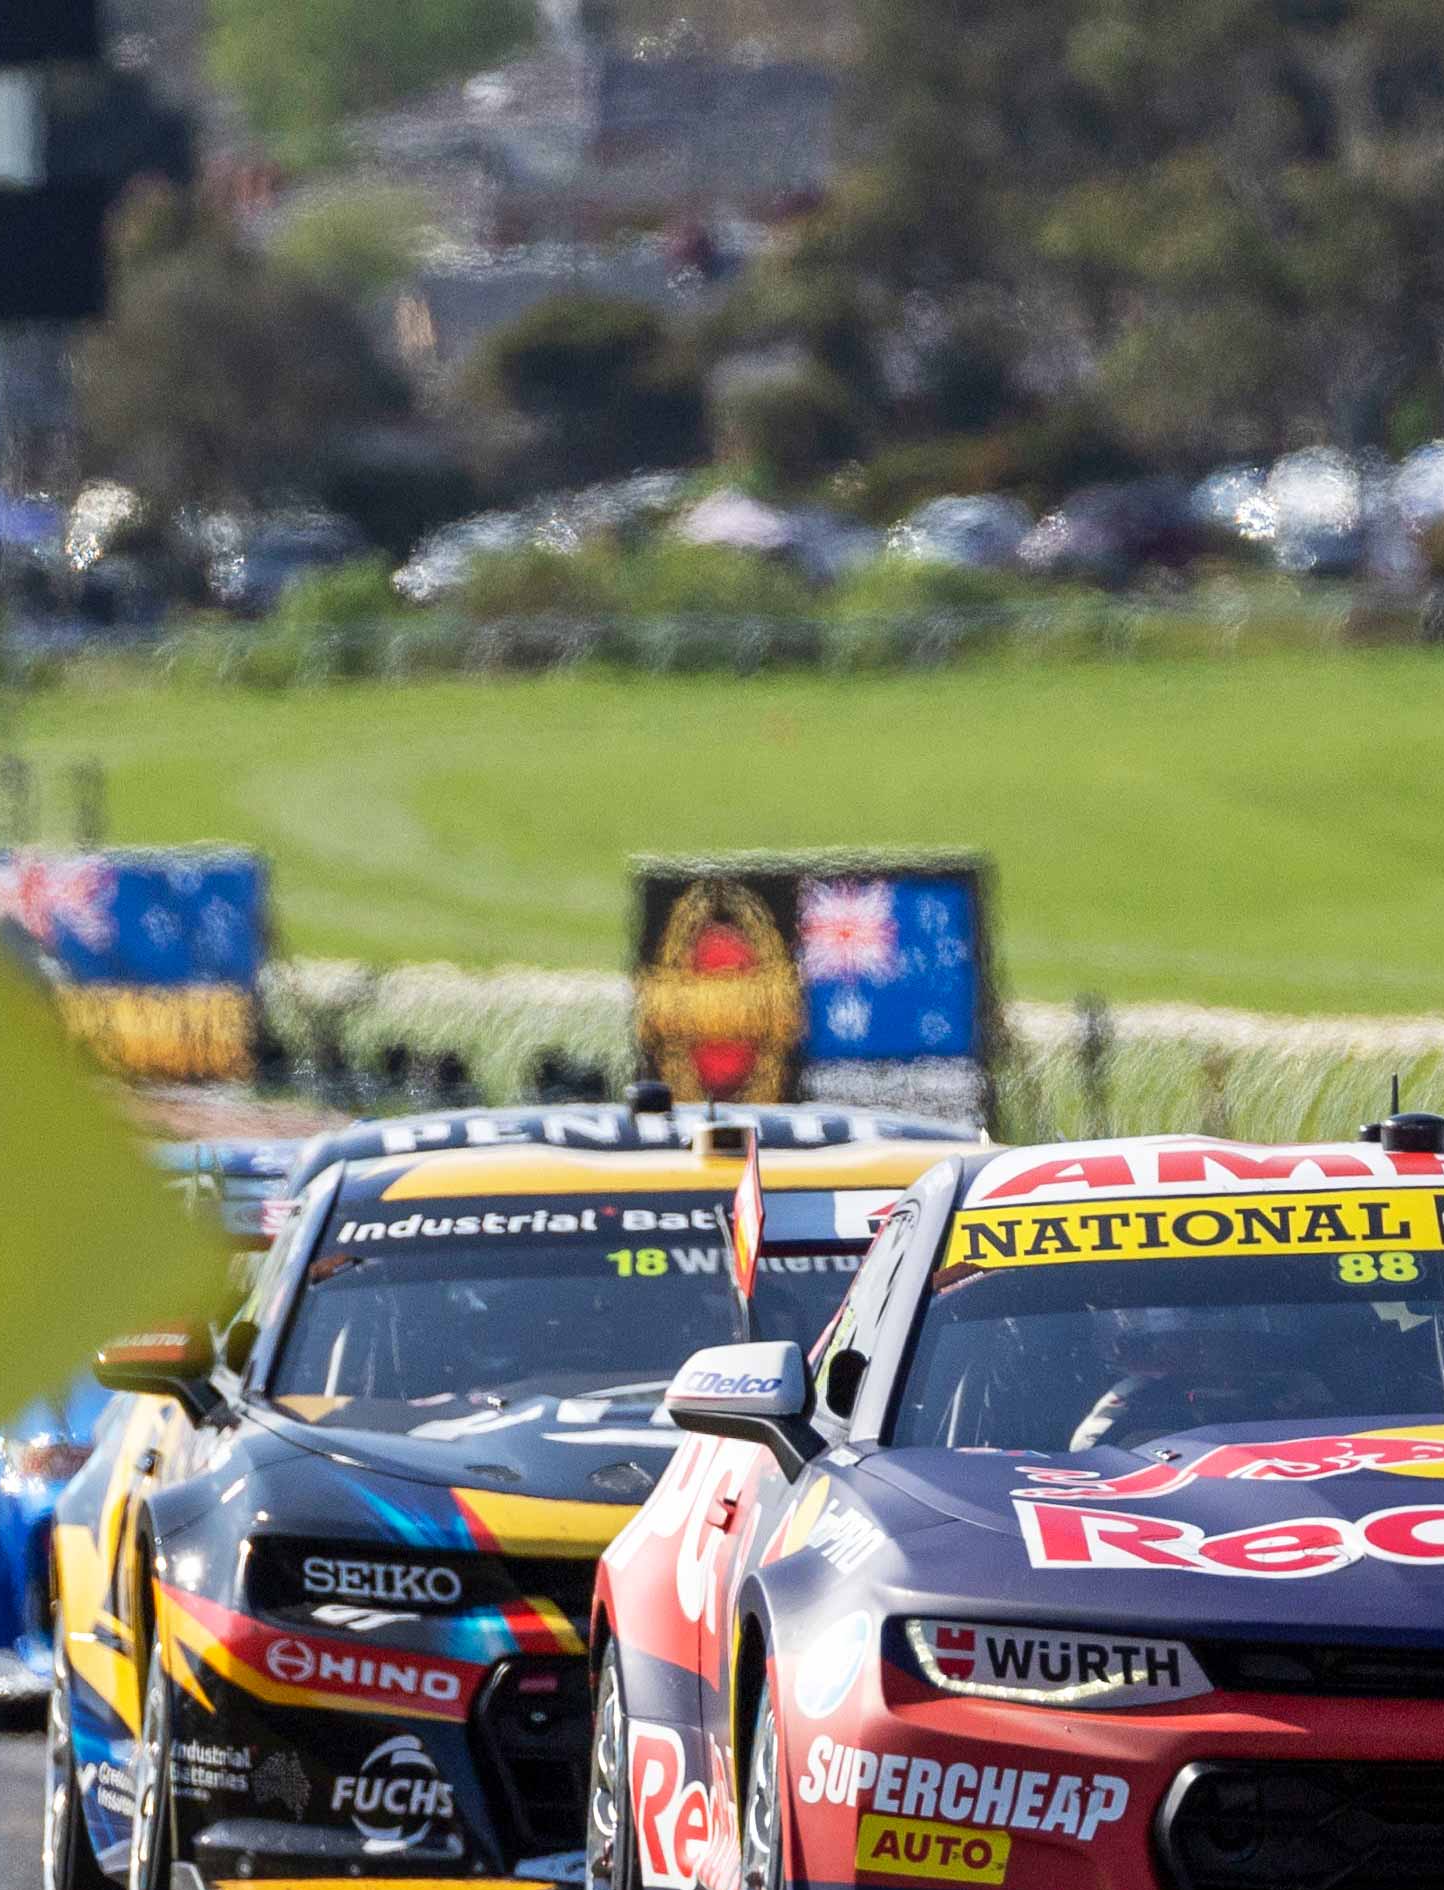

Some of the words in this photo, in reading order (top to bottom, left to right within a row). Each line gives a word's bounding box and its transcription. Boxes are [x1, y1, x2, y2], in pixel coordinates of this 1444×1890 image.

[337, 1207, 599, 1244] Industrial
[960, 1202, 1412, 1262] NATIONAL
[608, 1249, 669, 1278] 18
[1336, 1253, 1420, 1284] 88
[303, 1556, 462, 1602] SEIKO
[320, 1653, 460, 1701] HINO
[985, 1637, 1181, 1687] WÜRTH
[331, 1775, 454, 1817] FUCHS
[798, 1735, 1131, 1842] SUPERCHEAP
[871, 1829, 994, 1872] AUTO
